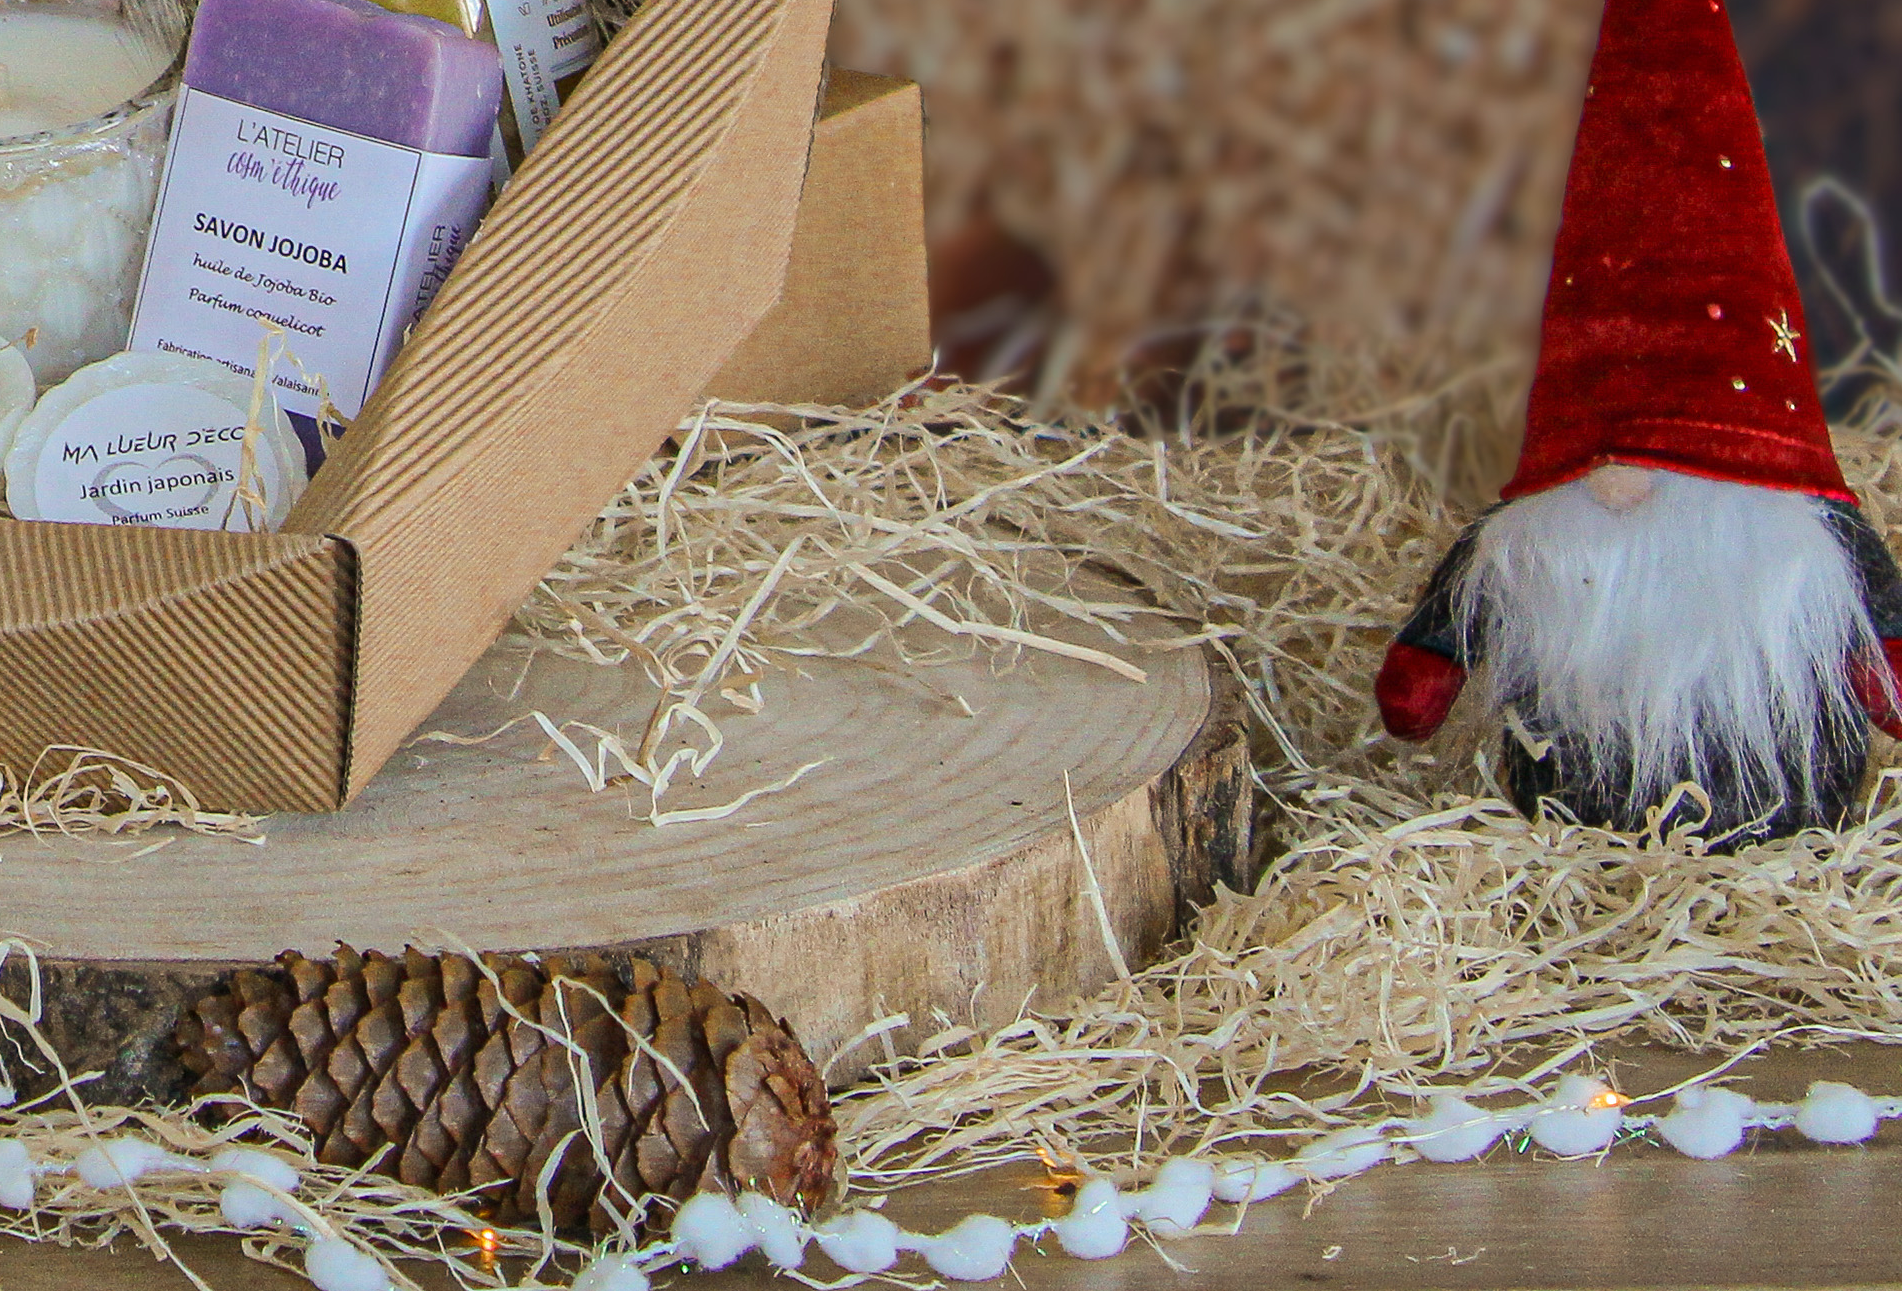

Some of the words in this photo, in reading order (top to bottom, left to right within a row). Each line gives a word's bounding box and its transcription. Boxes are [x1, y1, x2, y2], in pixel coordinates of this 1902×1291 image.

[512, 43, 538, 110] KHATONE
[526, 48, 545, 95] SUISSE
[236, 118, 346, 169] L'ATELIER
[193, 211, 265, 250] SAVON
[267, 234, 348, 275] JOJOBA
[192, 251, 233, 276] huile
[233, 266, 255, 283] de
[252, 272, 308, 298] Jojoba
[307, 288, 338, 307] Bio
[188, 287, 245, 315] Parfum
[245, 305, 327, 339] coquelicot
[62, 441, 99, 465] MA
[106, 430, 178, 457] LUEUR
[79, 477, 142, 501] Jardin
[146, 466, 235, 496] japonais
[111, 511, 163, 527] Parfum
[166, 503, 210, 520] Suisse
